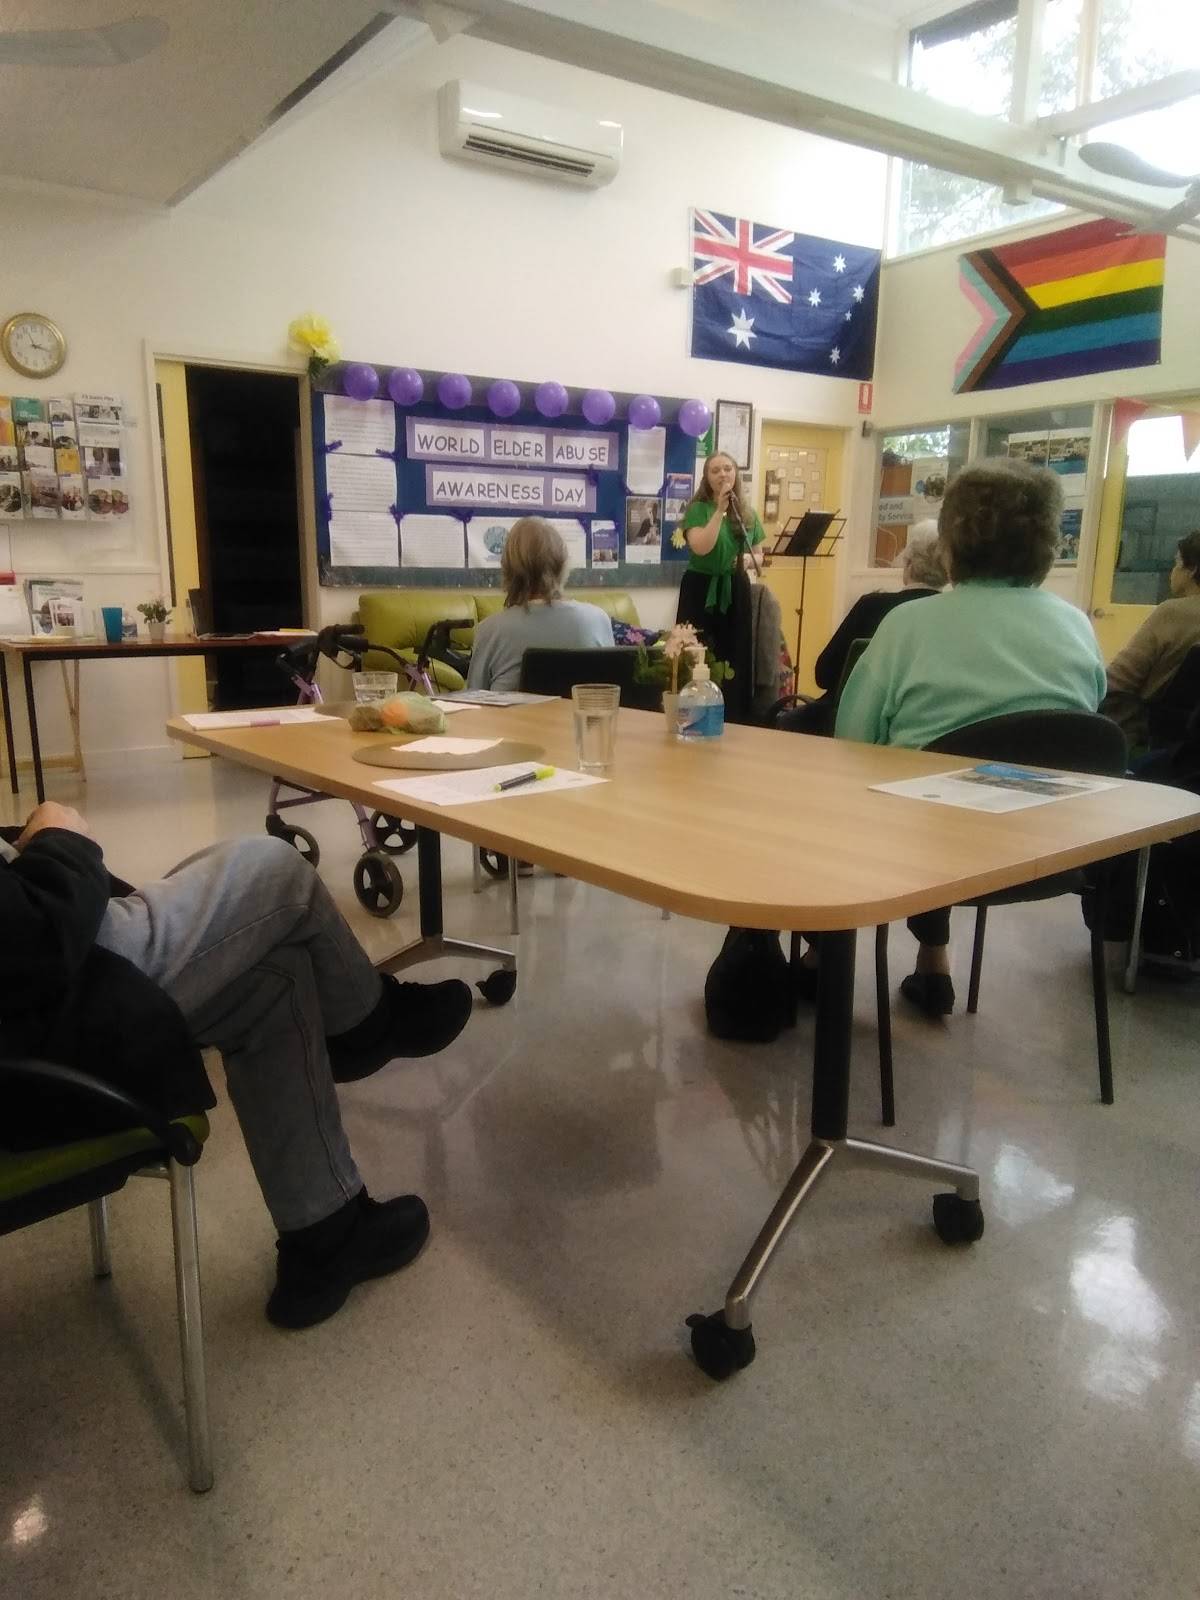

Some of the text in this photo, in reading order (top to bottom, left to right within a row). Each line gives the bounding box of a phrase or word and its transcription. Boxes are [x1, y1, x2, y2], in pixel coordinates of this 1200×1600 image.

[417, 434, 607, 461] WORLD ELDER ABUSE
[436, 481, 584, 502] AWARENESS DAY
